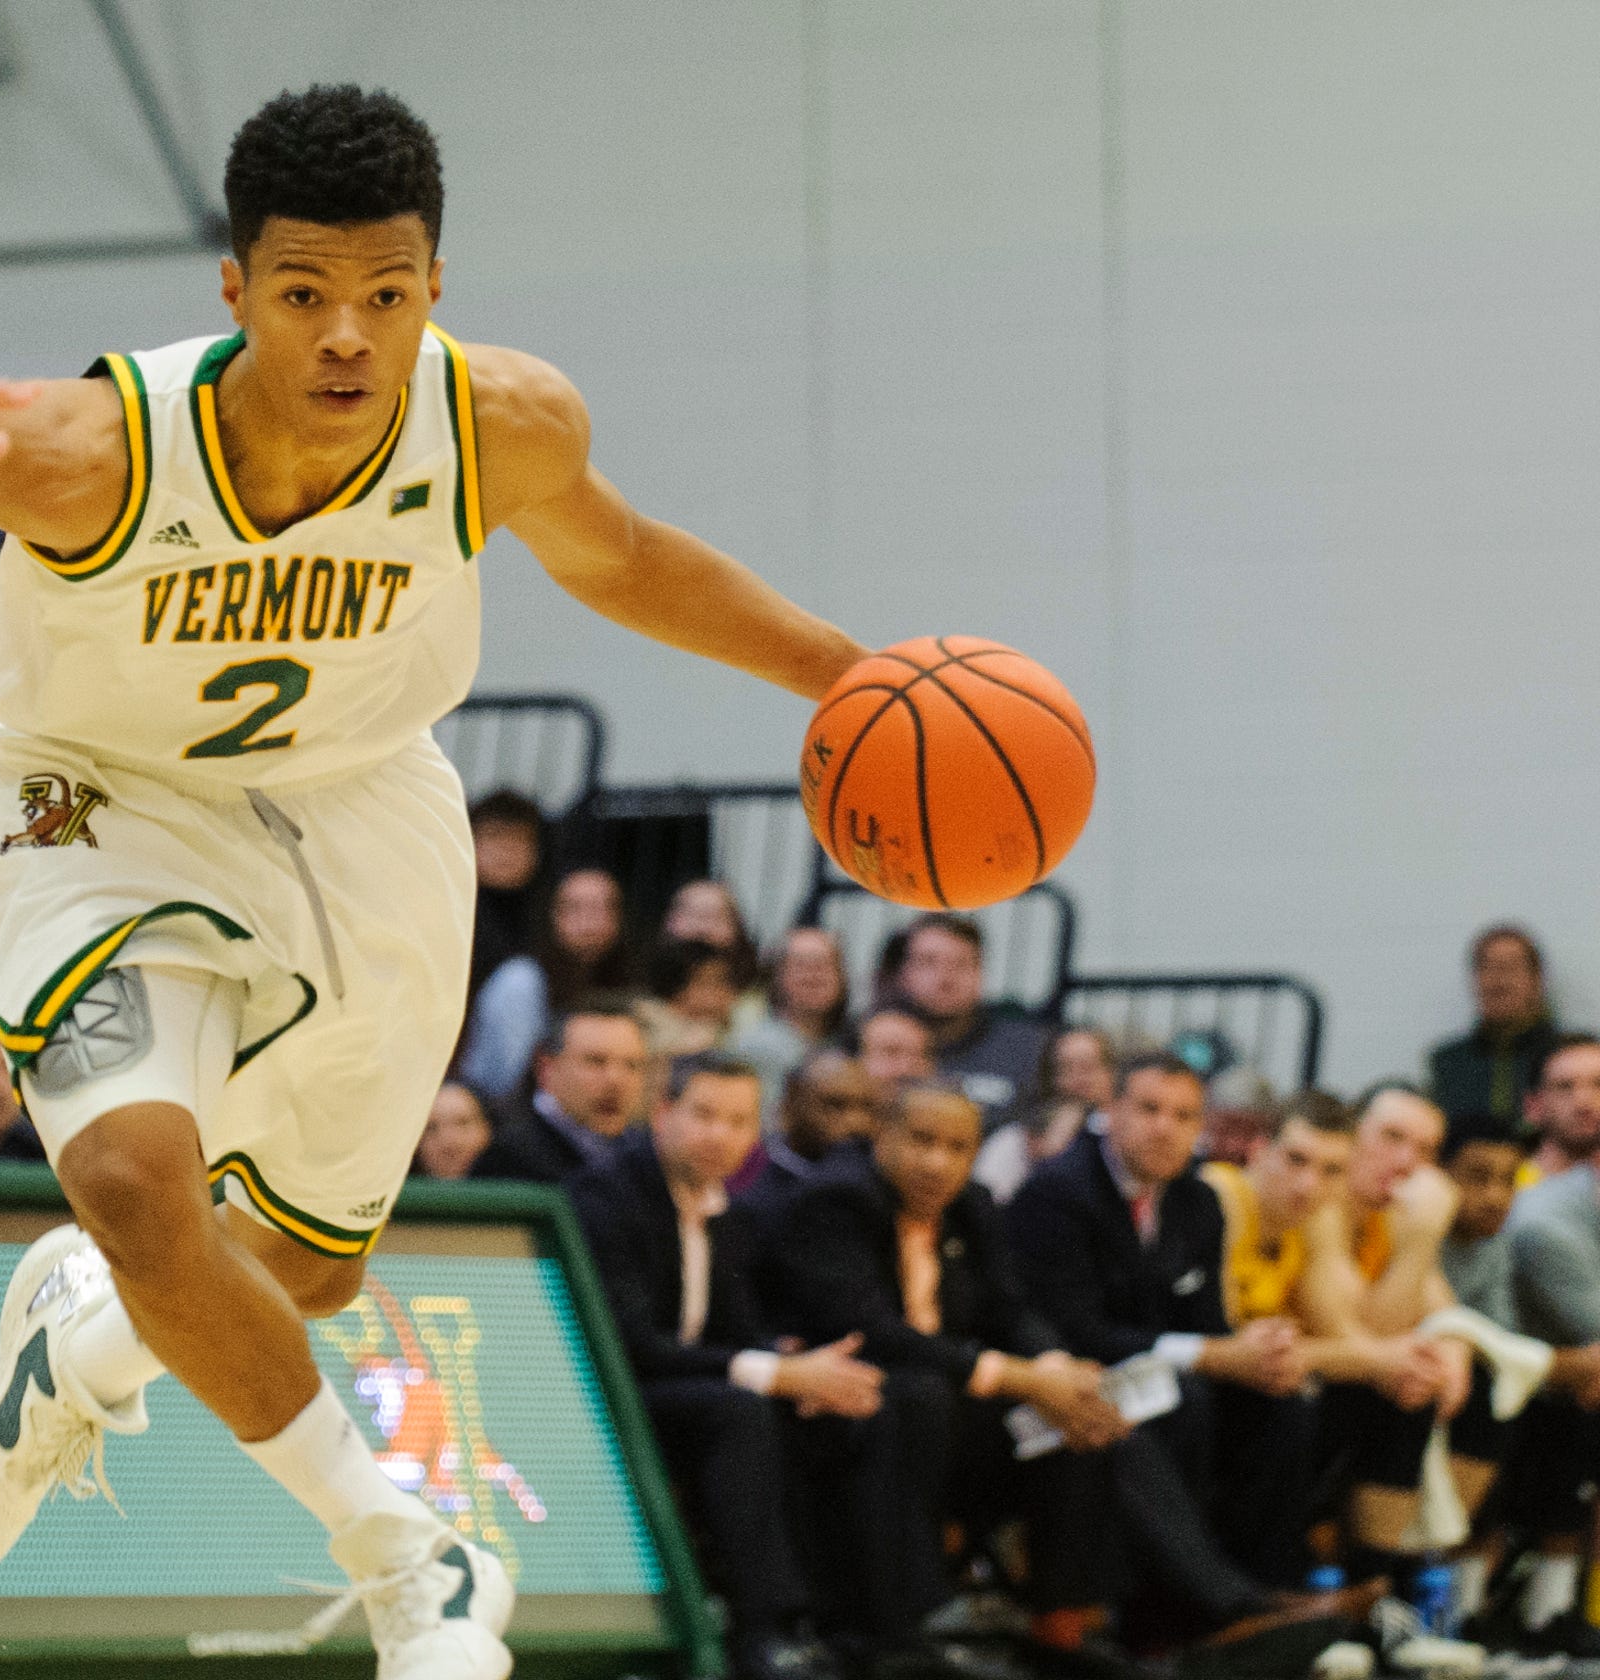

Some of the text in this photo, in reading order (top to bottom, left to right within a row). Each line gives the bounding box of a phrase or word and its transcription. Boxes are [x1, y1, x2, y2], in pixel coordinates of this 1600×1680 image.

[148, 534, 201, 550] adidas
[142, 555, 413, 644] VERMONT
[181, 654, 314, 760] 2
